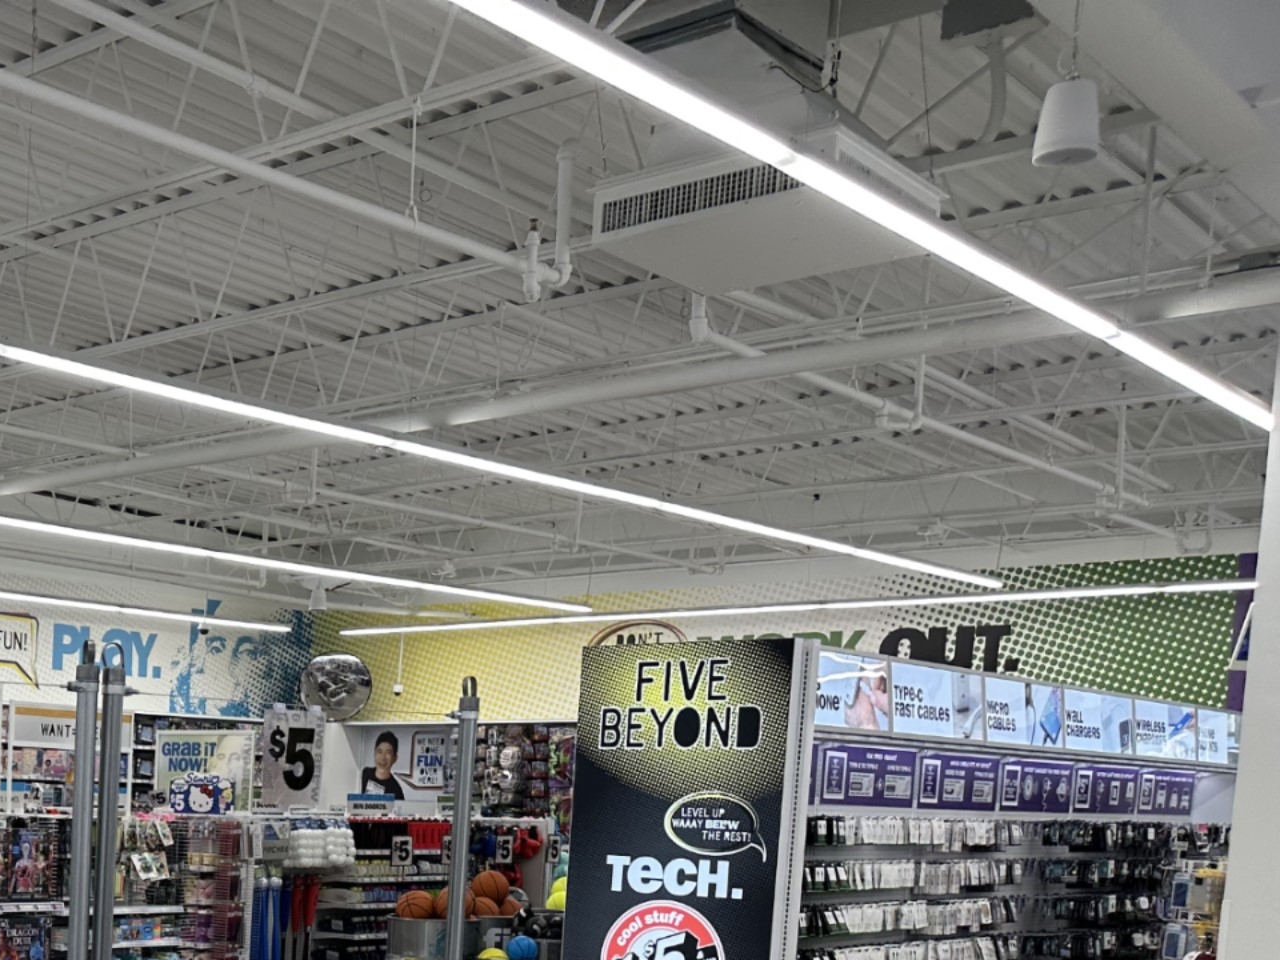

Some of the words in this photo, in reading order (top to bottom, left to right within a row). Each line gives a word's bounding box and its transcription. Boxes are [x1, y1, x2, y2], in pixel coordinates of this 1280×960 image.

[636, 658, 731, 702] FIVE
[599, 705, 763, 750] BEYOND
[169, 758, 208, 773] NOW!
[269, 725, 315, 790] $5
[417, 755, 443, 767] FUN
[672, 818, 703, 829] WAAAY
[681, 808, 709, 817] LEVEL
[712, 808, 725, 818] UP
[702, 831, 721, 840] THE
[724, 832, 752, 842] REST!
[394, 840, 410, 864] $5
[498, 839, 510, 860] $5
[617, 916, 643, 946] cool
[644, 911, 684, 926] stuff
